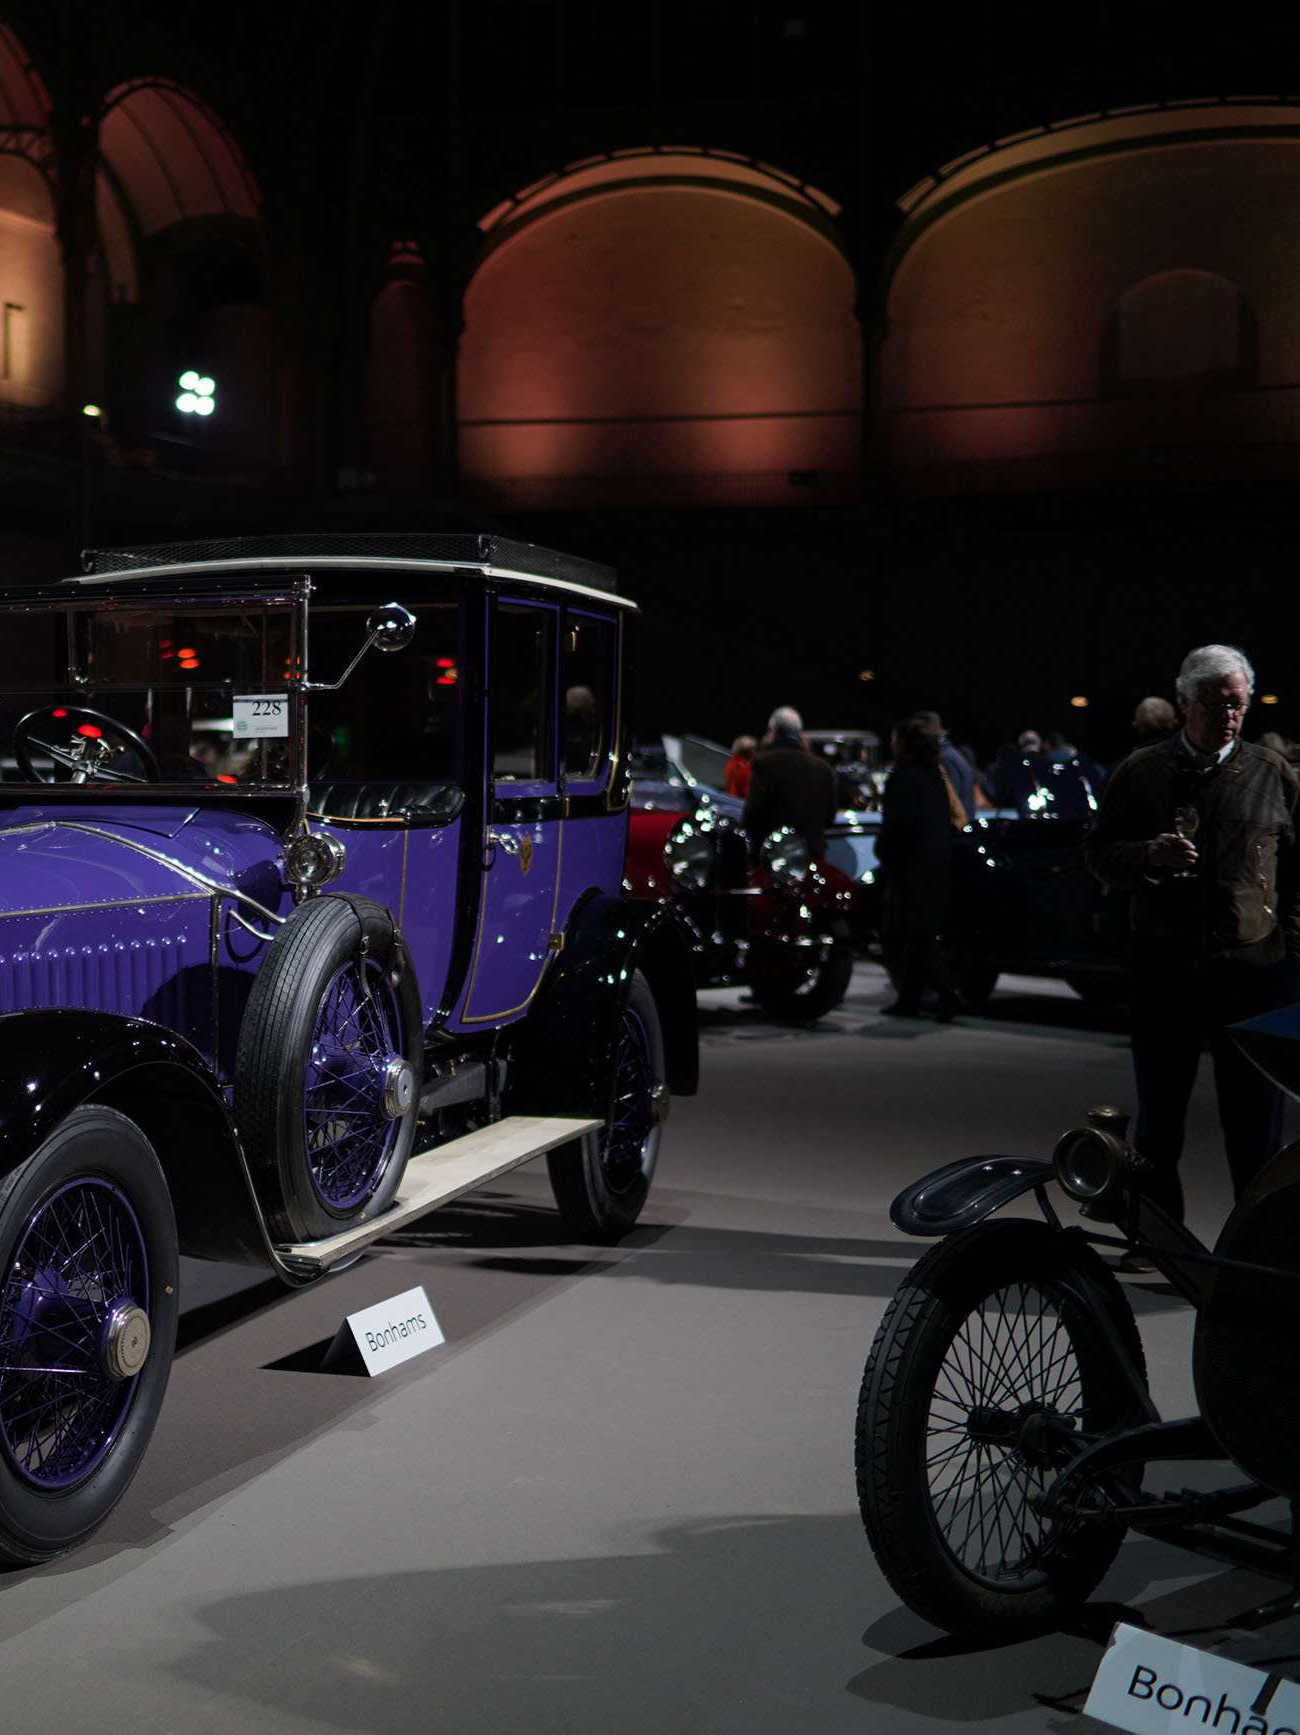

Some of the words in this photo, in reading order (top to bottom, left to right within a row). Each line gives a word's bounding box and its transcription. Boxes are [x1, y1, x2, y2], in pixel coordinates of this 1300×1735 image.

[252, 700, 282, 716] 228
[365, 1314, 427, 1352] Bonhams
[1127, 1664, 1297, 1735] Bonha
